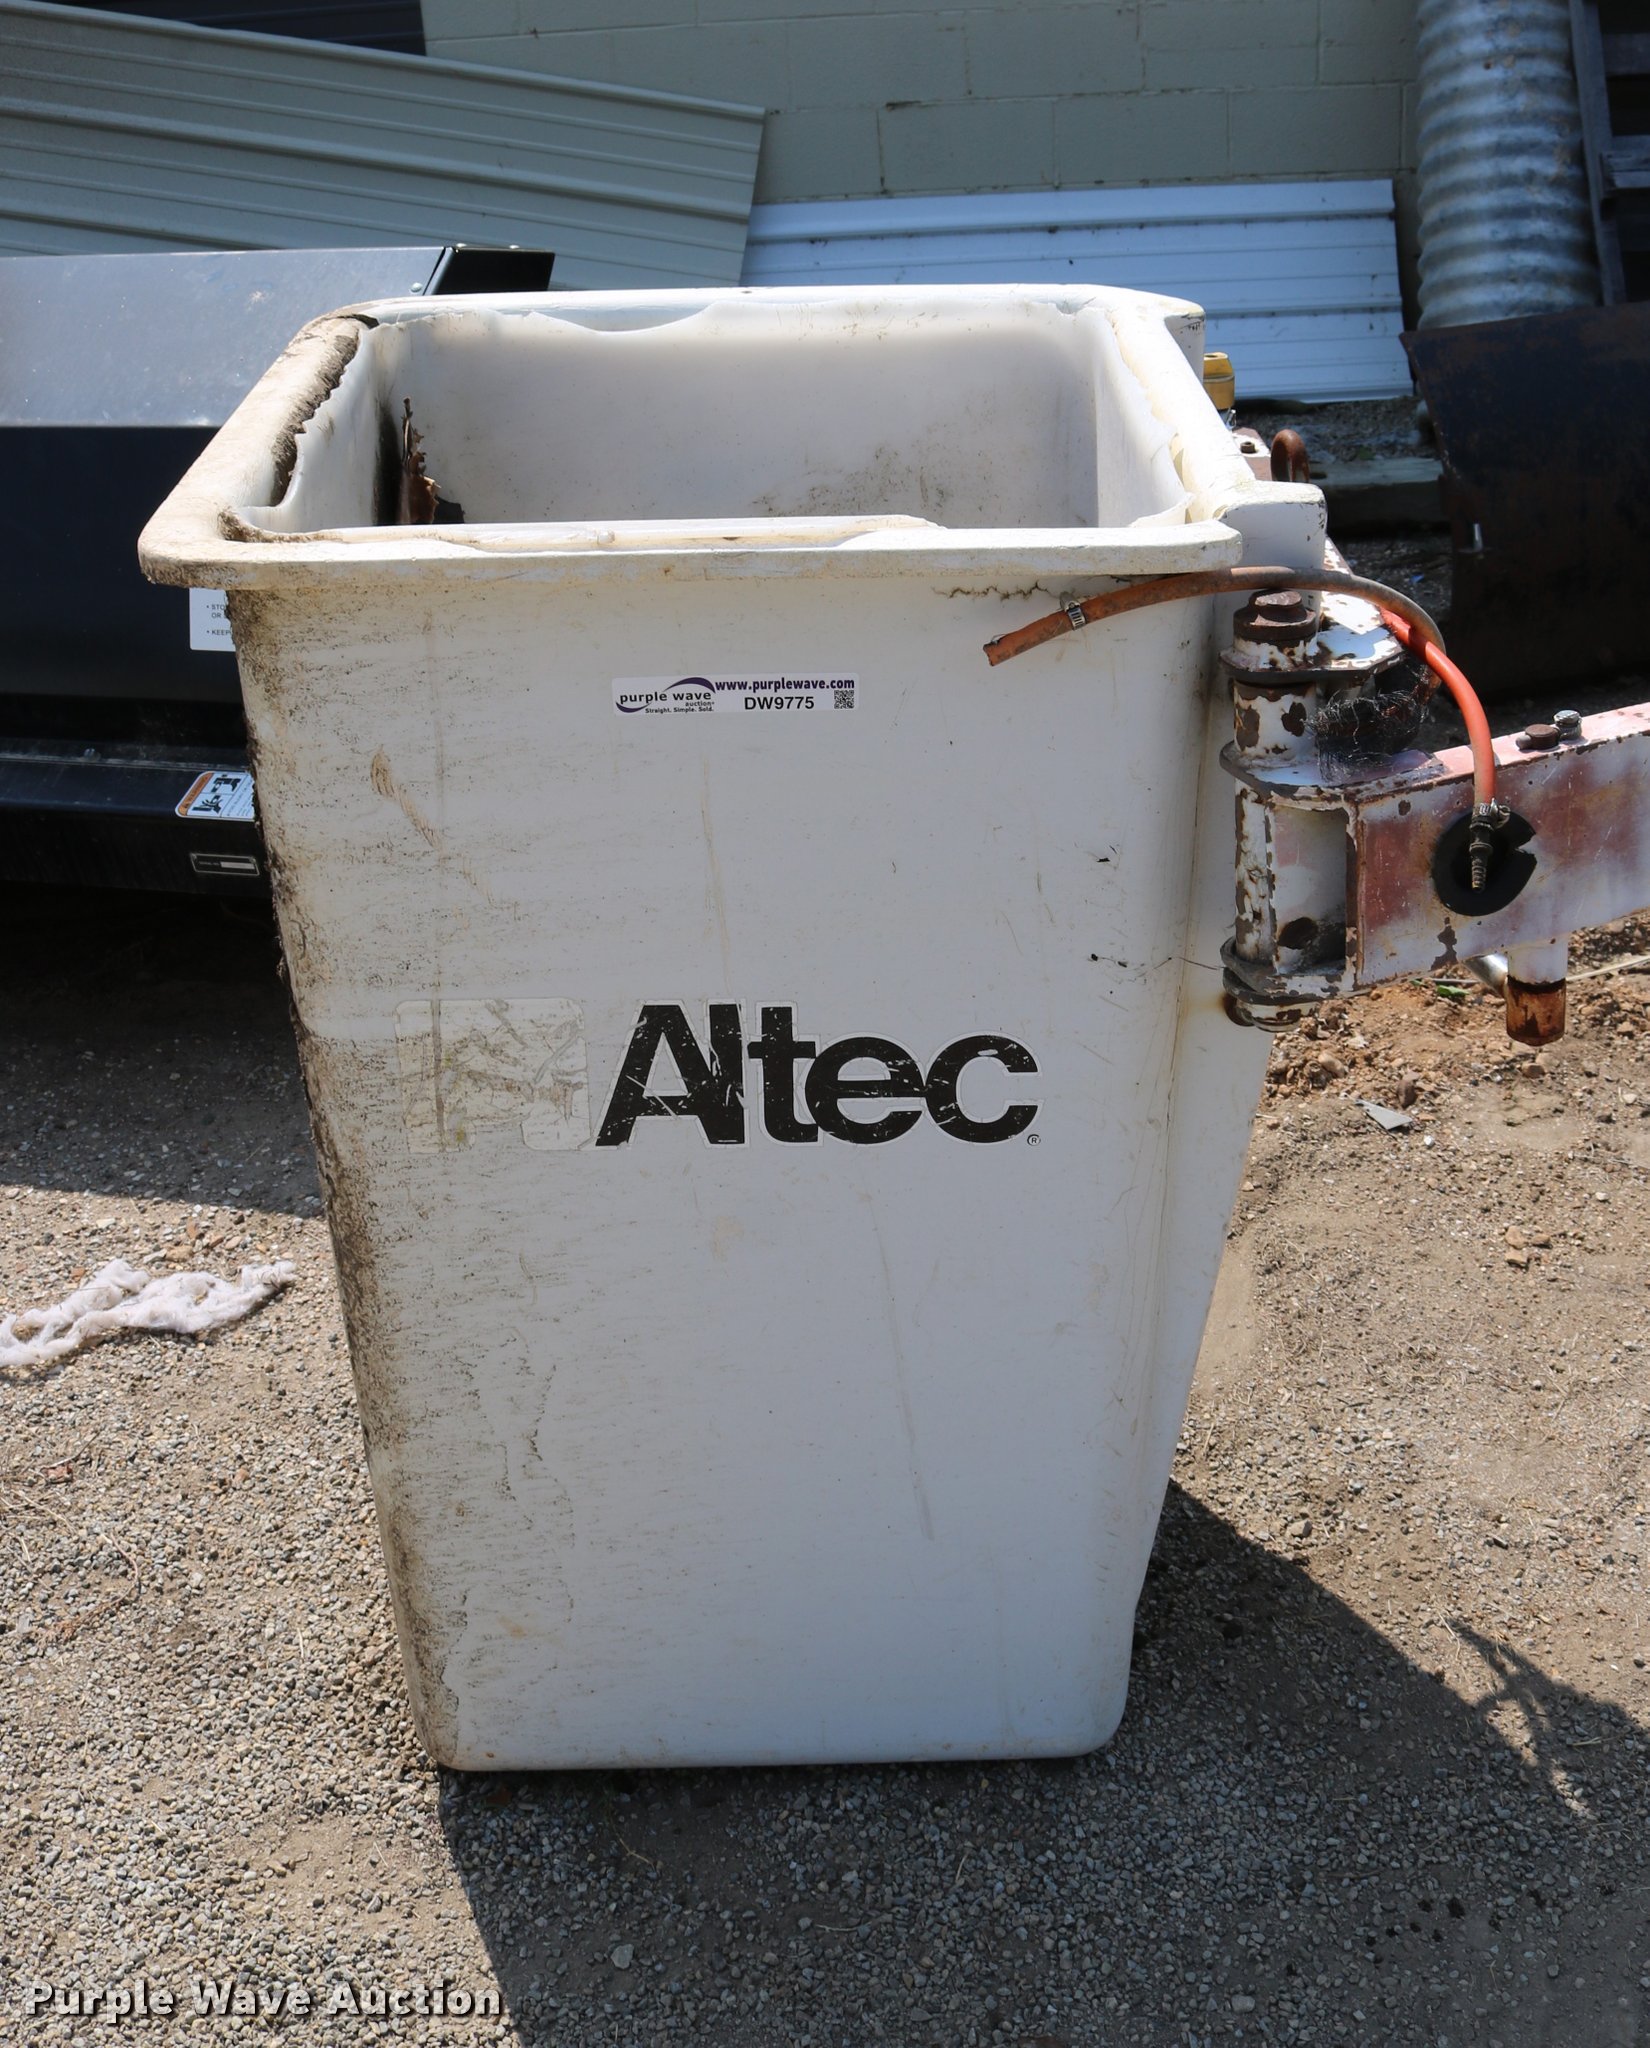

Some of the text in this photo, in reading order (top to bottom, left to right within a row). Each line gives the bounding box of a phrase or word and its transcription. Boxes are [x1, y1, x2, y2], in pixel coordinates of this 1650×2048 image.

[715, 677, 855, 694] www.purplewave.com
[619, 691, 712, 705] purple wave
[744, 696, 815, 711] DW9775
[645, 707, 672, 715] Straight.
[673, 706, 697, 714] Simple.
[595, 1002, 1040, 1146] Altec
